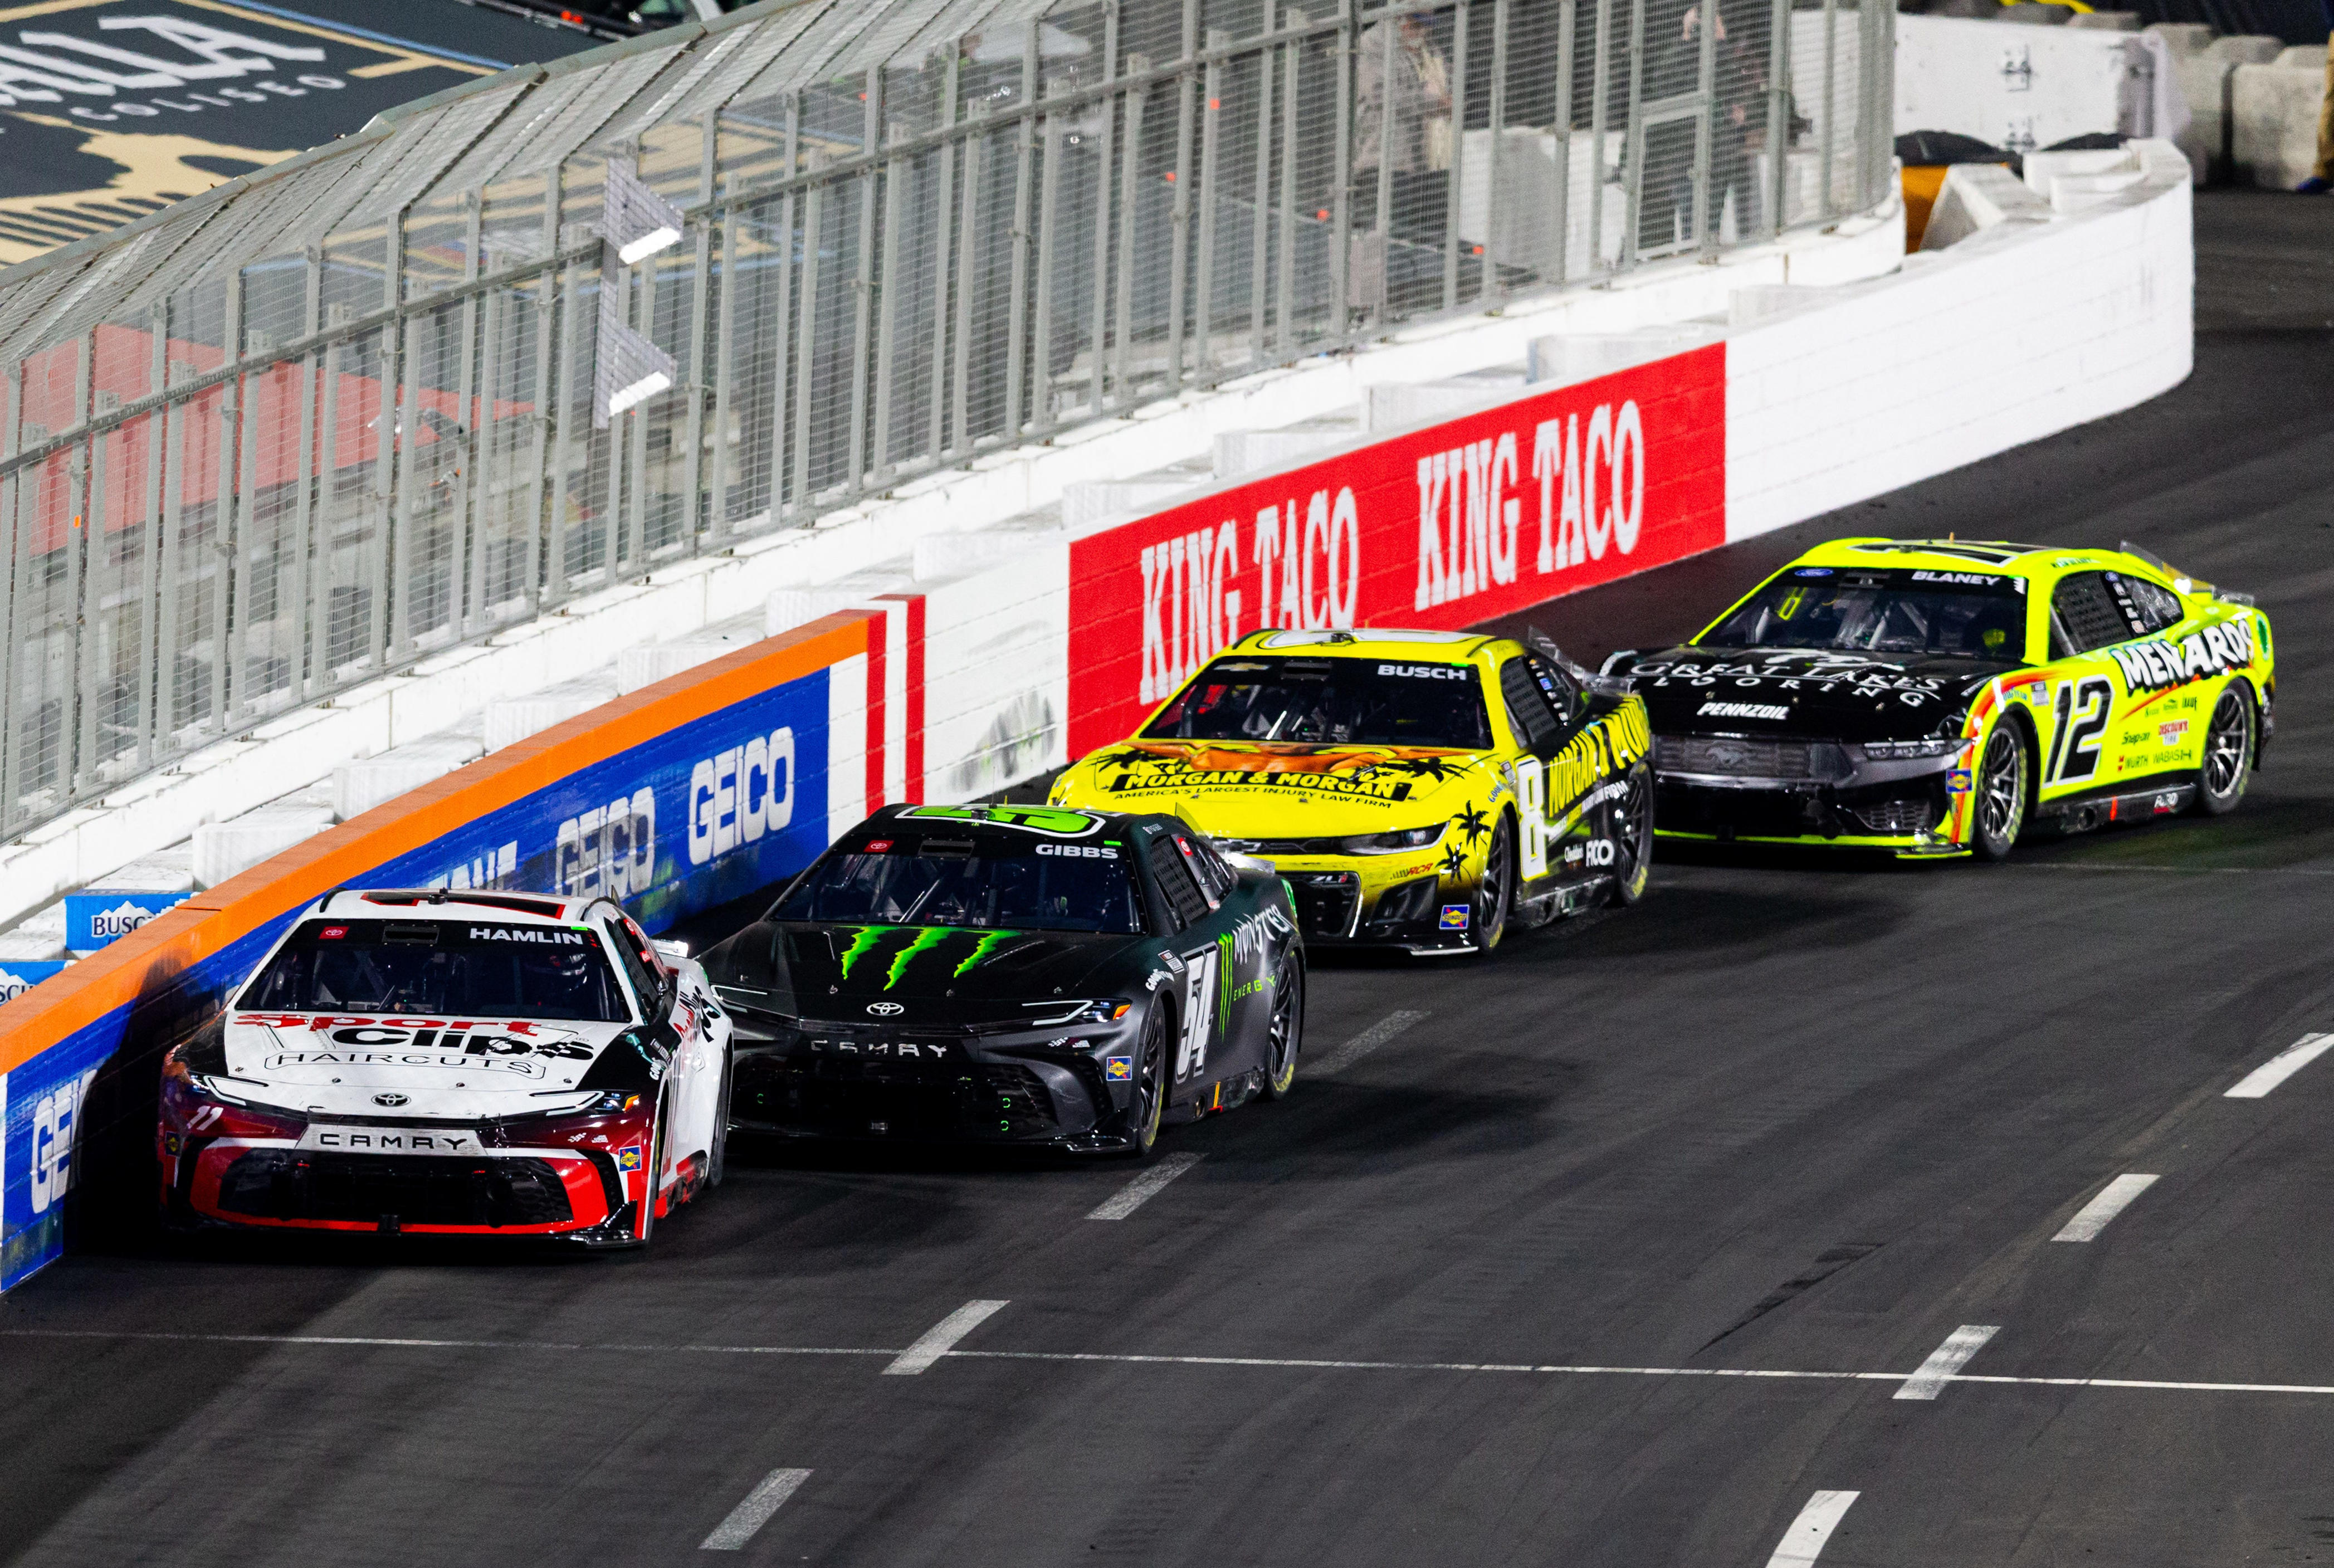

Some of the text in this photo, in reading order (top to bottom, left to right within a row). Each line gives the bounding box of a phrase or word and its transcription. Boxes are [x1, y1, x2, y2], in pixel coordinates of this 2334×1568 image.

[1418, 400, 1645, 612] KING TACO
[1911, 571, 2000, 586] BLANEY
[1140, 486, 1359, 706] KING TACO
[2110, 619, 2255, 693] MENARDS
[1377, 665, 1467, 681] BUSCH
[1653, 676, 1925, 707] LOORING
[1697, 702, 1790, 720] PENNZOIL
[2043, 674, 2115, 789] 12
[689, 726, 794, 865] GEICO
[1114, 787, 1191, 800] AMERICA'S
[1263, 787, 1316, 798] INJURY
[1355, 798, 1392, 809] FIRM
[1124, 772, 1395, 798] MORGAN & MORGAN
[1513, 754, 1548, 881] 8
[555, 786, 655, 898] GEICO
[1036, 844, 1118, 859] GIBBS
[1586, 839, 1615, 867] FICO
[93, 916, 153, 936] BUSC
[470, 927, 583, 945] HAMLIN
[1233, 975, 1275, 1001] ENERGY
[233, 1014, 541, 1036] Sport
[1175, 941, 1218, 1084] 54
[332, 1028, 594, 1061] Clips
[277, 1052, 533, 1074] HAIRCUTS
[320, 1133, 467, 1151] CAMRY
